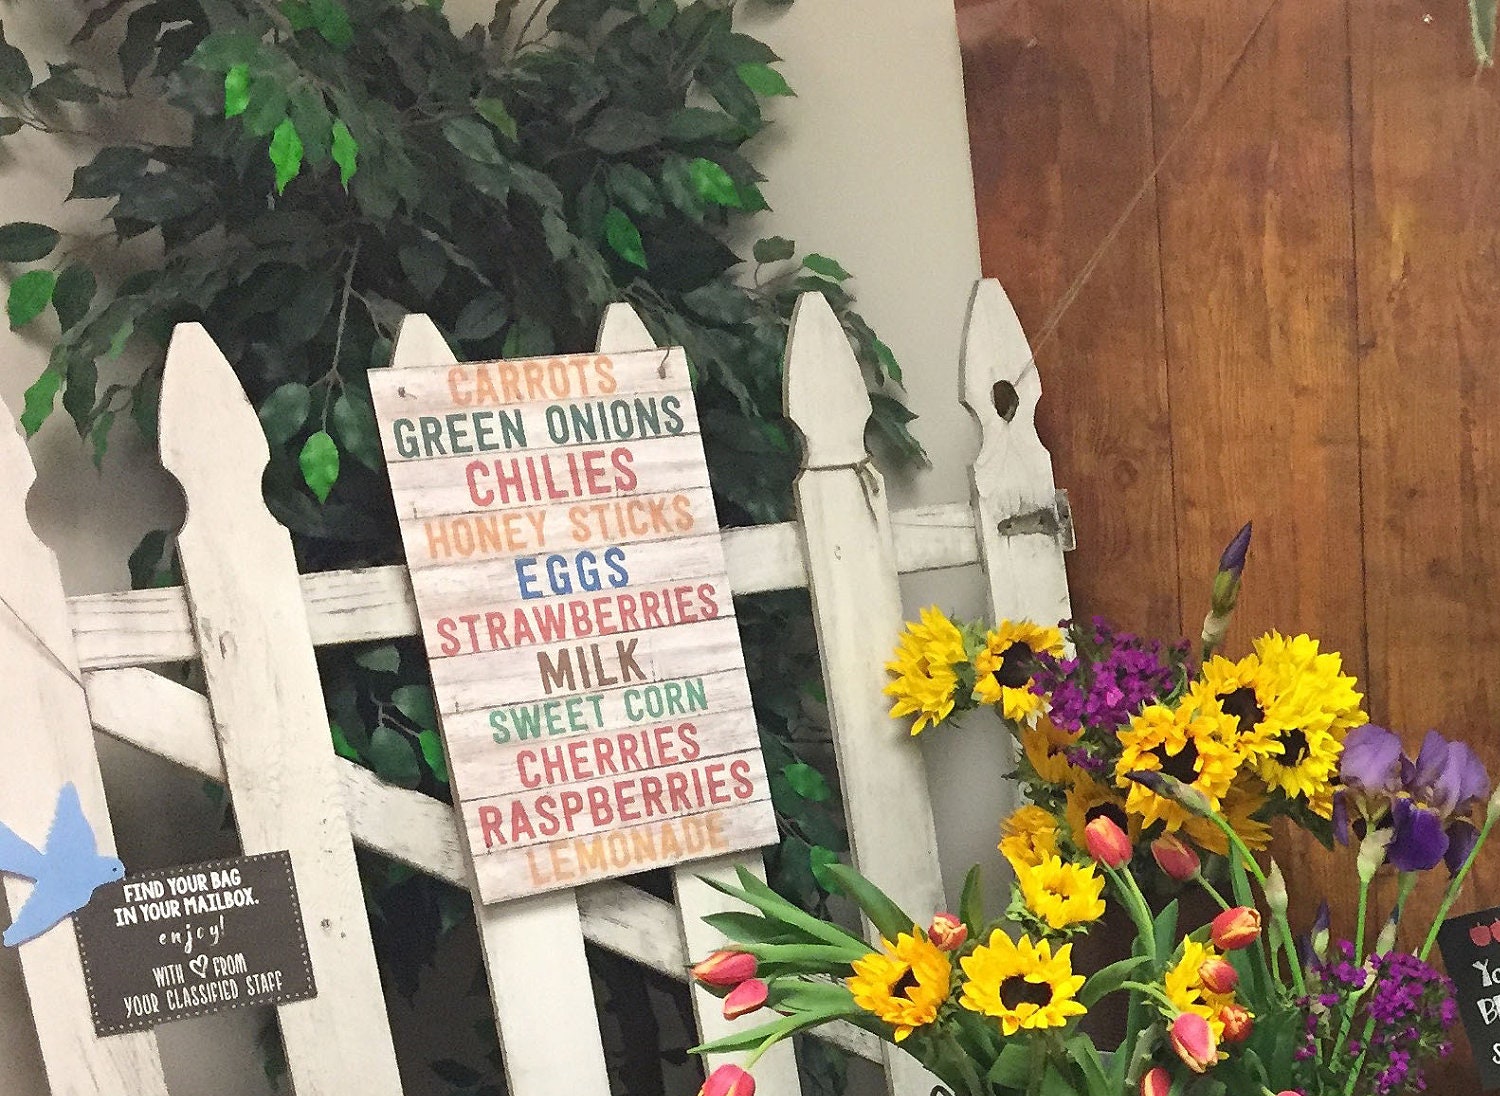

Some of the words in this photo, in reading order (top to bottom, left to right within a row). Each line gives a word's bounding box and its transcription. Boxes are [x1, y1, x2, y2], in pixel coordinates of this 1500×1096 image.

[447, 355, 619, 408] CARROTS
[393, 409, 527, 458] GREEN
[547, 395, 685, 441] ONIONS
[464, 447, 638, 507] CHILIES
[423, 509, 547, 560] HONEY
[571, 495, 697, 544] STICKS
[514, 547, 630, 600] EGGS
[436, 582, 720, 658] STRAWBERRIES
[536, 637, 649, 695] MILK
[489, 697, 606, 745] SWEET
[623, 678, 709, 722] CORN
[516, 722, 702, 789] CHERRIES
[477, 759, 756, 849] RASPBERRIES
[527, 815, 731, 888] LEMONADE
[114, 907, 138, 927] IN
[140, 899, 182, 922] YOUR
[184, 886, 260, 916] MAILBOX.
[123, 880, 165, 903] FIND
[167, 873, 208, 895] YOUR
[210, 868, 241, 890] BAG
[158, 914, 225, 954] enjoy!
[123, 995, 160, 1019] YOUR
[166, 978, 239, 1011] CLASSIFIED
[247, 970, 283, 997] STAFF
[152, 962, 185, 988] WITH
[212, 952, 248, 977] FROM
